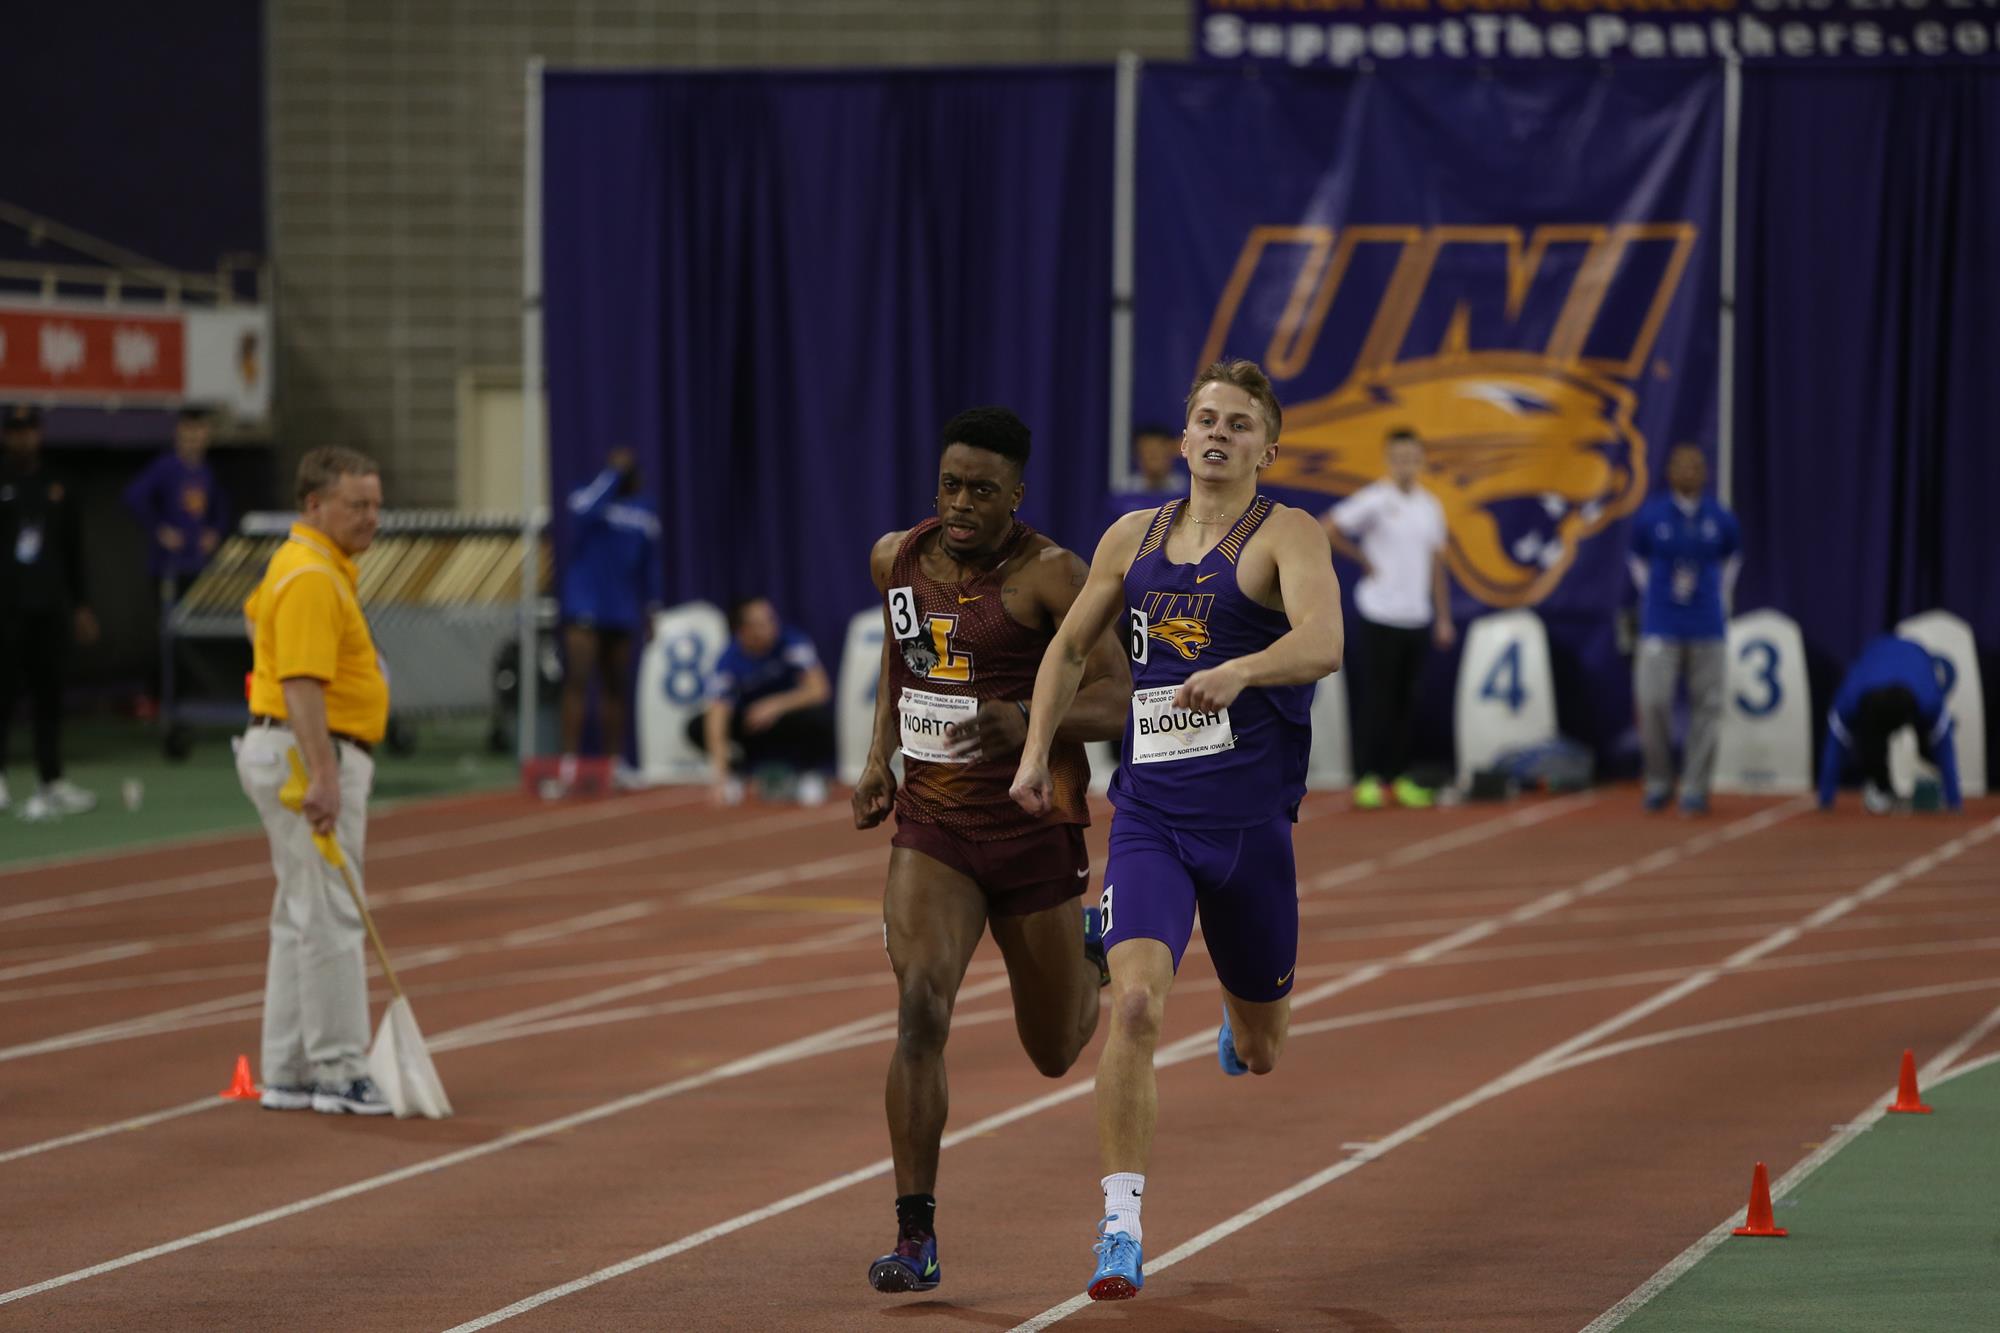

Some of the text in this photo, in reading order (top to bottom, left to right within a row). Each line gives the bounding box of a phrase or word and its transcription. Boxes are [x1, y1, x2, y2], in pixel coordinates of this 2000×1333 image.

[1204, 12, 2000, 66] SupportThePanthers.co
[1196, 225, 1697, 396] UNI
[893, 592, 912, 635] 3
[1140, 590, 1216, 622] UNI
[1132, 612, 1144, 660] 6
[664, 632, 705, 705] 8
[1480, 638, 1530, 714] 4
[1736, 638, 1783, 719] 3
[1160, 689, 1173, 697] MVC
[1139, 711, 1221, 736] BLOUGH
[1139, 751, 1167, 760] UNIVERSITY
[1177, 745, 1209, 755] NORTHERN
[1209, 742, 1226, 750] IOWA
